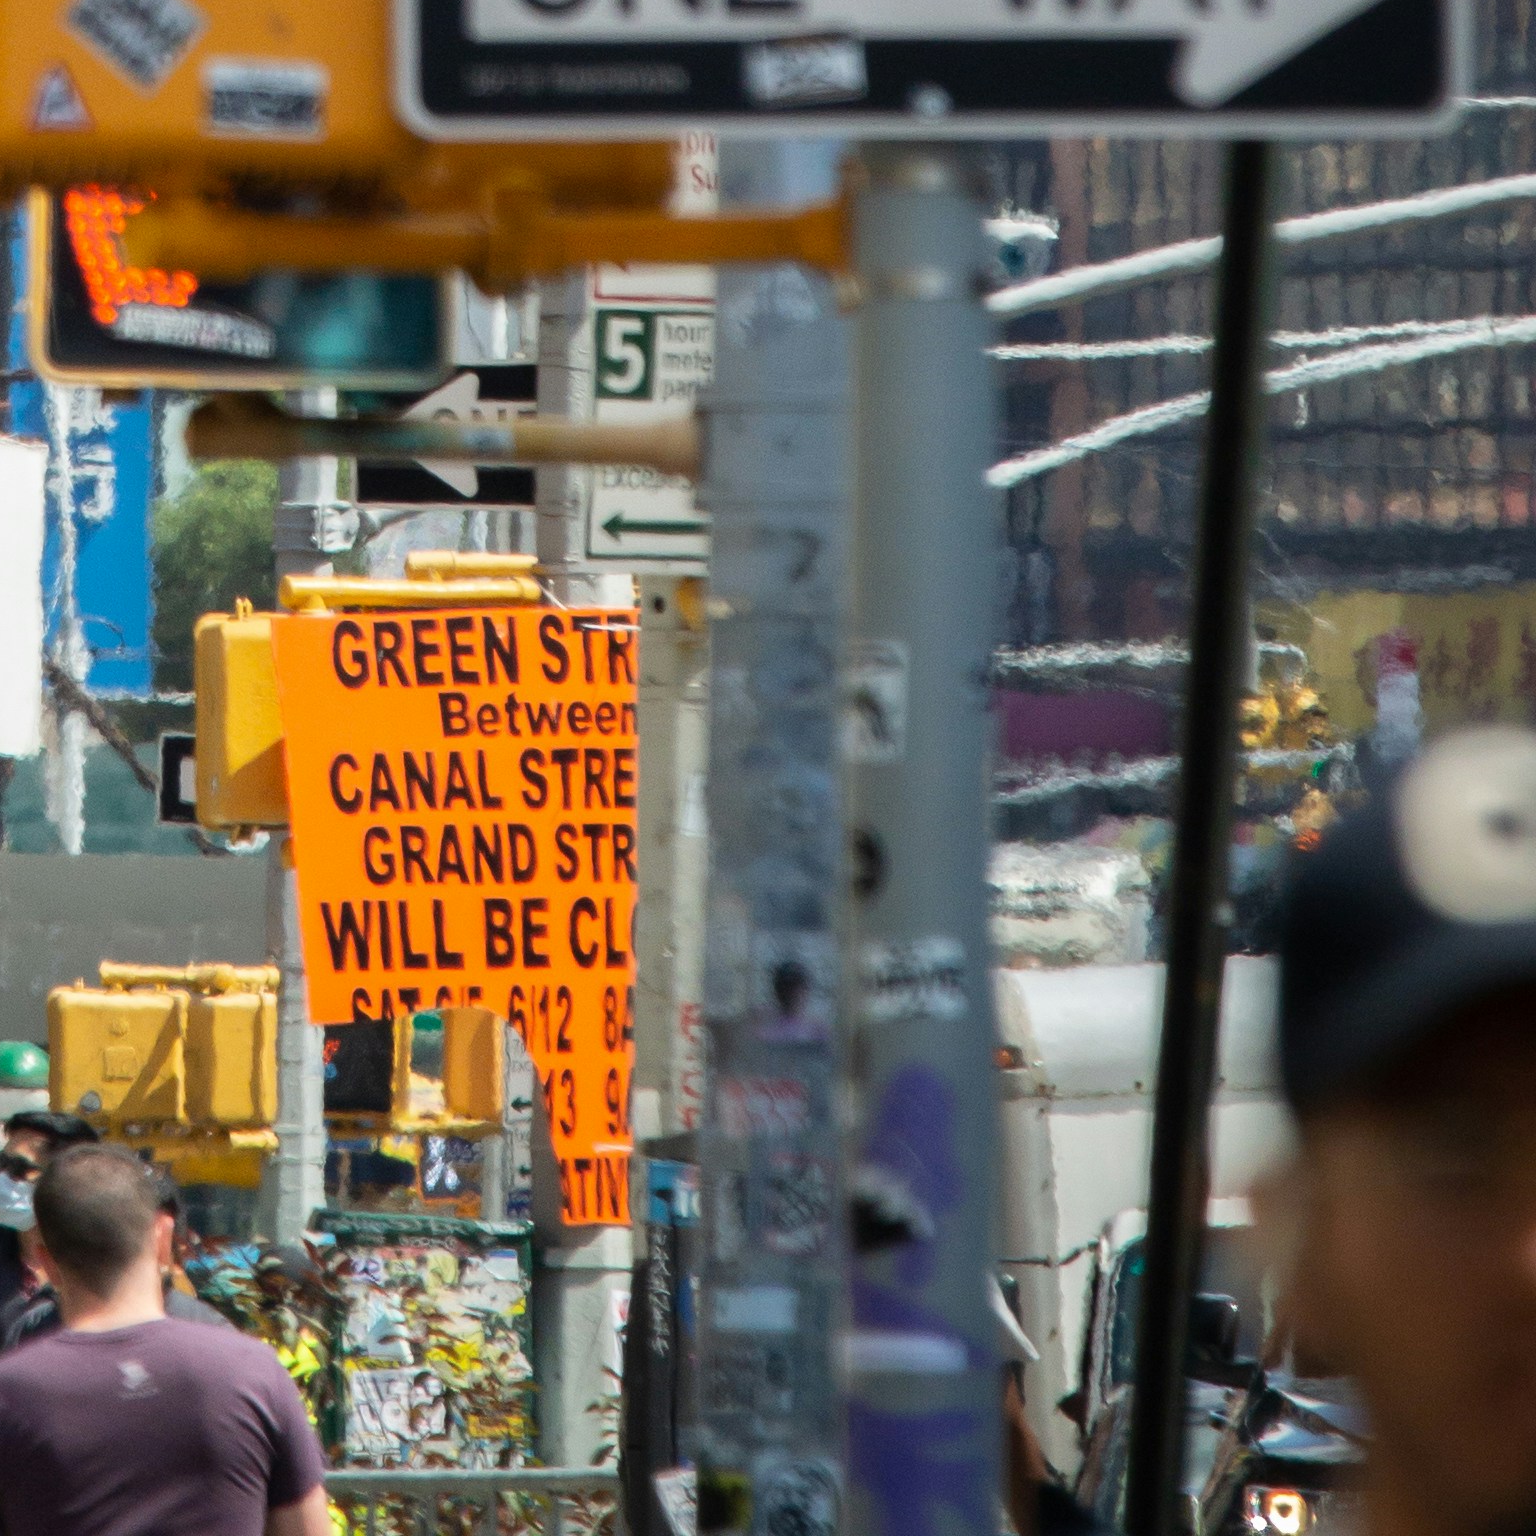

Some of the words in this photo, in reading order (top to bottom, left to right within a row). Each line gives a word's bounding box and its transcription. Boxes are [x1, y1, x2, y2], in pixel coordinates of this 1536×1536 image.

[601, 315, 646, 394] 5
[333, 616, 520, 689] GREEN
[438, 691, 638, 738] Between
[329, 749, 504, 814] CANAL
[364, 824, 538, 886] GRAND
[320, 899, 466, 972] WILL
[483, 897, 552, 969] BE
